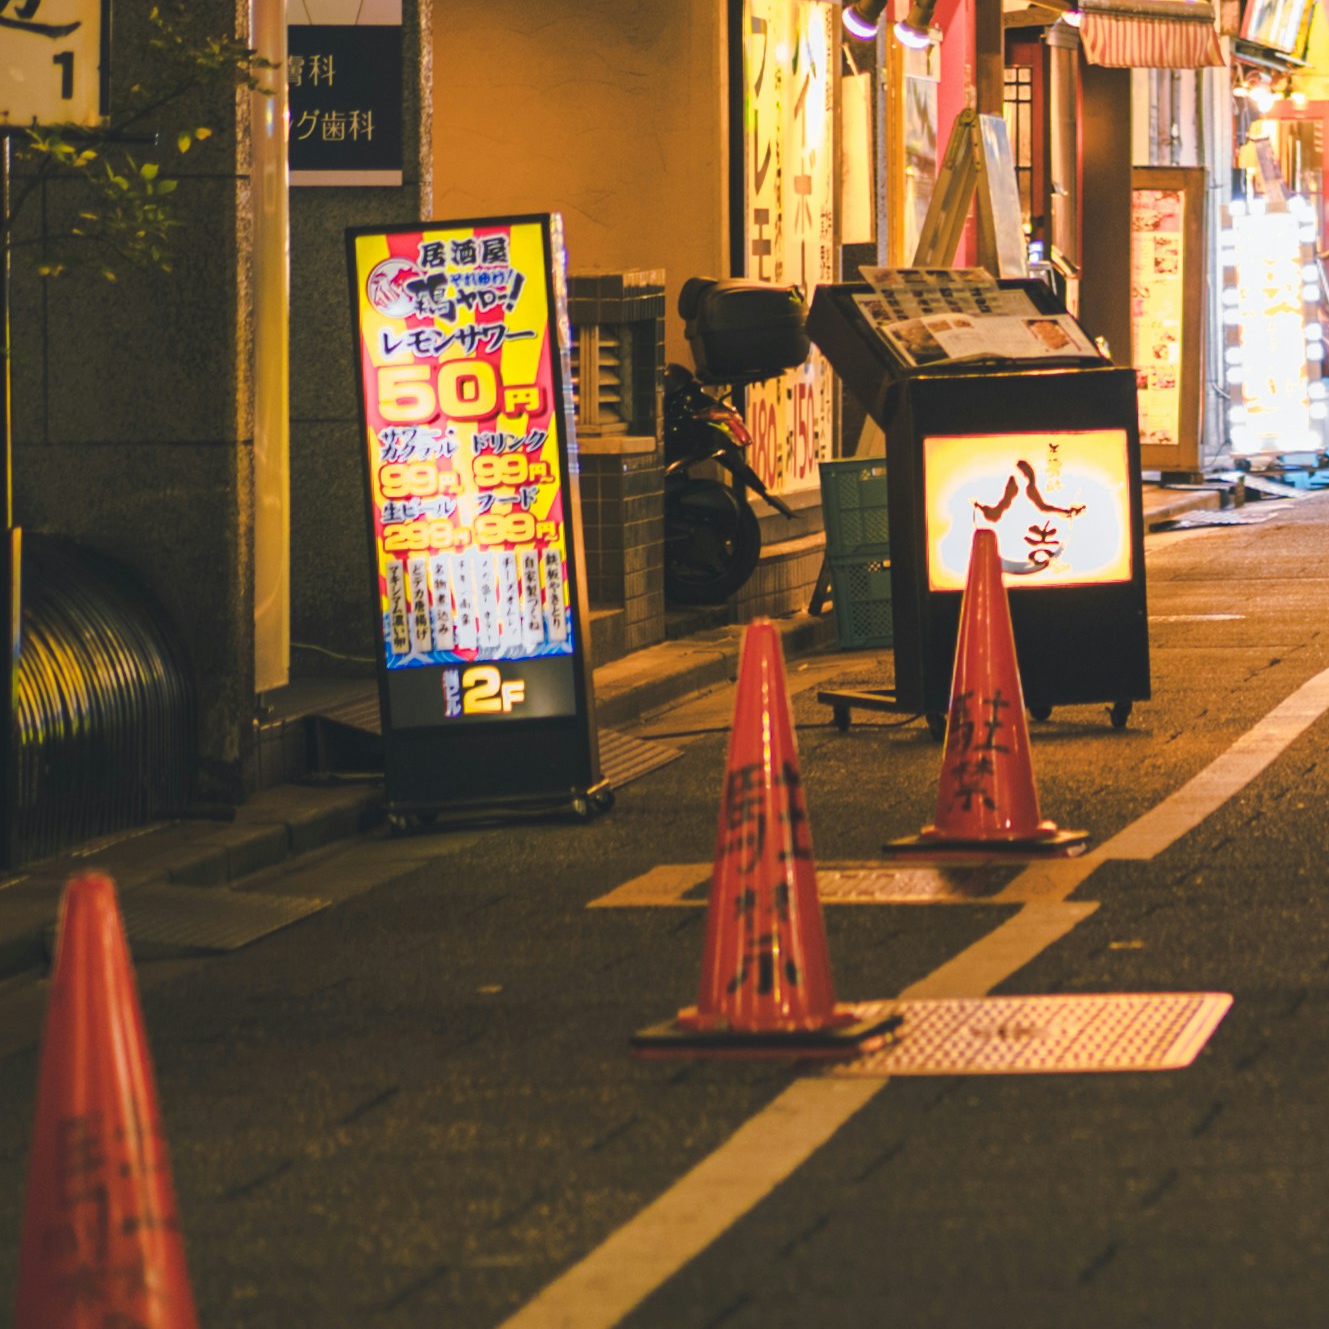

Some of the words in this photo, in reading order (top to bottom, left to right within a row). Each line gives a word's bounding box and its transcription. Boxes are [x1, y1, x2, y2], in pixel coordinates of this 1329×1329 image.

[289, 109, 376, 142] グ歯科
[421, 237, 510, 268] 居酒屋
[406, 271, 526, 323] 鶏ヤロー!
[382, 323, 537, 356] レモンサワー
[377, 359, 540, 423] 50円
[472, 429, 549, 454] ドリンク
[382, 502, 456, 523] 生ビール
[476, 486, 540, 514] フード
[524, 557, 541, 632] 自家製つくね
[545, 552, 562, 629] 鉄板やきとり
[461, 665, 525, 715] 2F
